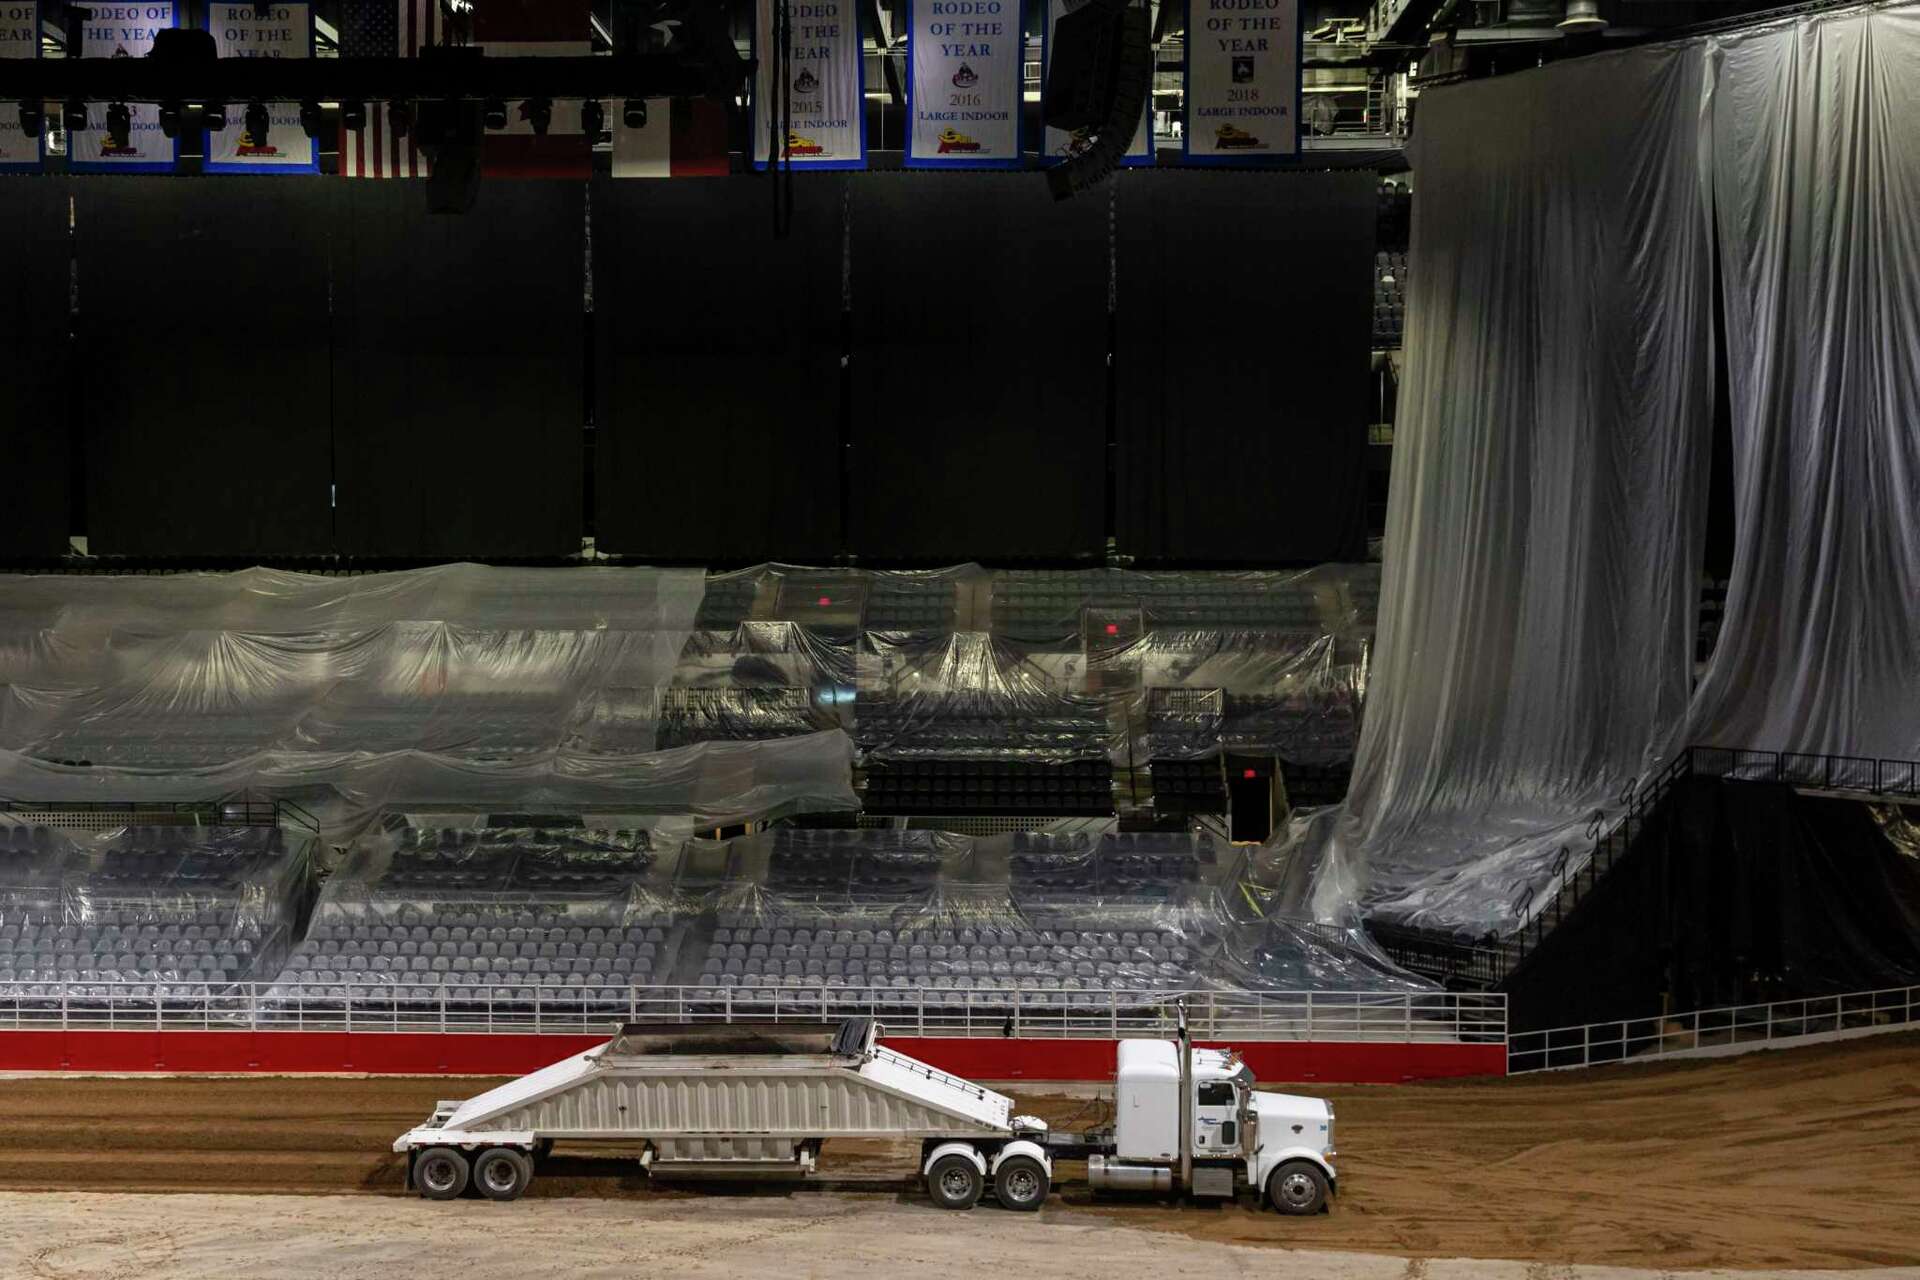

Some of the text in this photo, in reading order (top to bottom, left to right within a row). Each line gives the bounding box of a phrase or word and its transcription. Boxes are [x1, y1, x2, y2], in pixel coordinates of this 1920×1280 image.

[932, 2, 1002, 16] RODEO
[1209, 0, 1279, 10] RODEO
[90, 7, 170, 20] ODEO OF
[227, 8, 290, 21] ROEO
[930, 22, 1002, 36] OF THE
[1206, 17, 1281, 31] OF THE
[0, 28, 33, 41] EAR
[82, 27, 157, 41] HE YEA
[225, 28, 292, 42] OF THE
[801, 25, 840, 38] THE
[941, 43, 991, 57] YEAR
[1218, 38, 1268, 52] YEAR
[794, 46, 831, 60] EAR
[949, 93, 981, 106] 2016
[1227, 88, 1260, 101] 2018
[792, 101, 823, 113] 2015
[1198, 106, 1288, 117] LARGE INDOOR
[920, 110, 1009, 121] LARGE INDOOR
[803, 119, 848, 129] INDOOR
